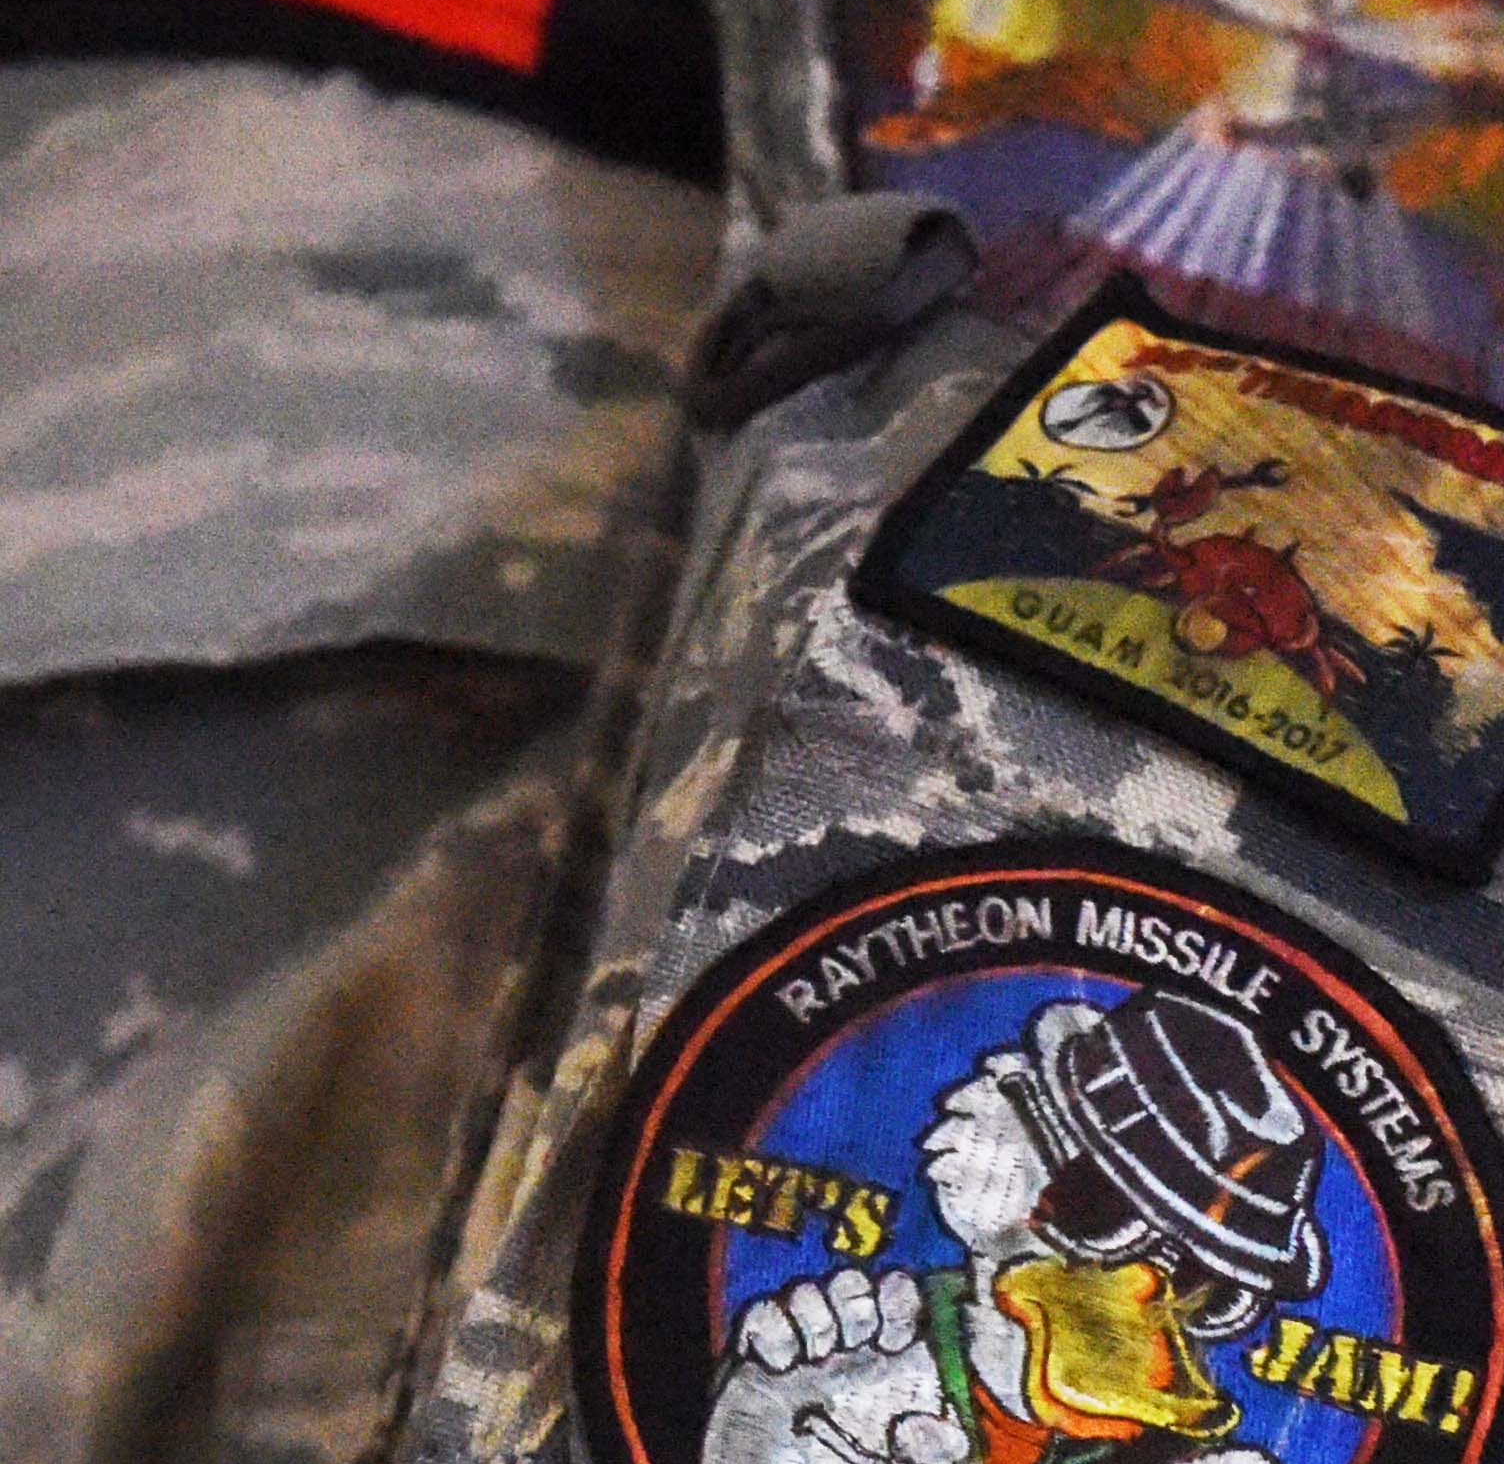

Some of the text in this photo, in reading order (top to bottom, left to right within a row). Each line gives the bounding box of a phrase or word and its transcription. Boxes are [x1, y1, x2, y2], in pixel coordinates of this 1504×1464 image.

[1011, 588, 1350, 764] GUAM 2016-2017
[775, 897, 1457, 1215] RAYTHEON MISSILE SYSTEMS
[663, 1147, 894, 1257] LET'S
[1251, 1318, 1475, 1435] JAM!
